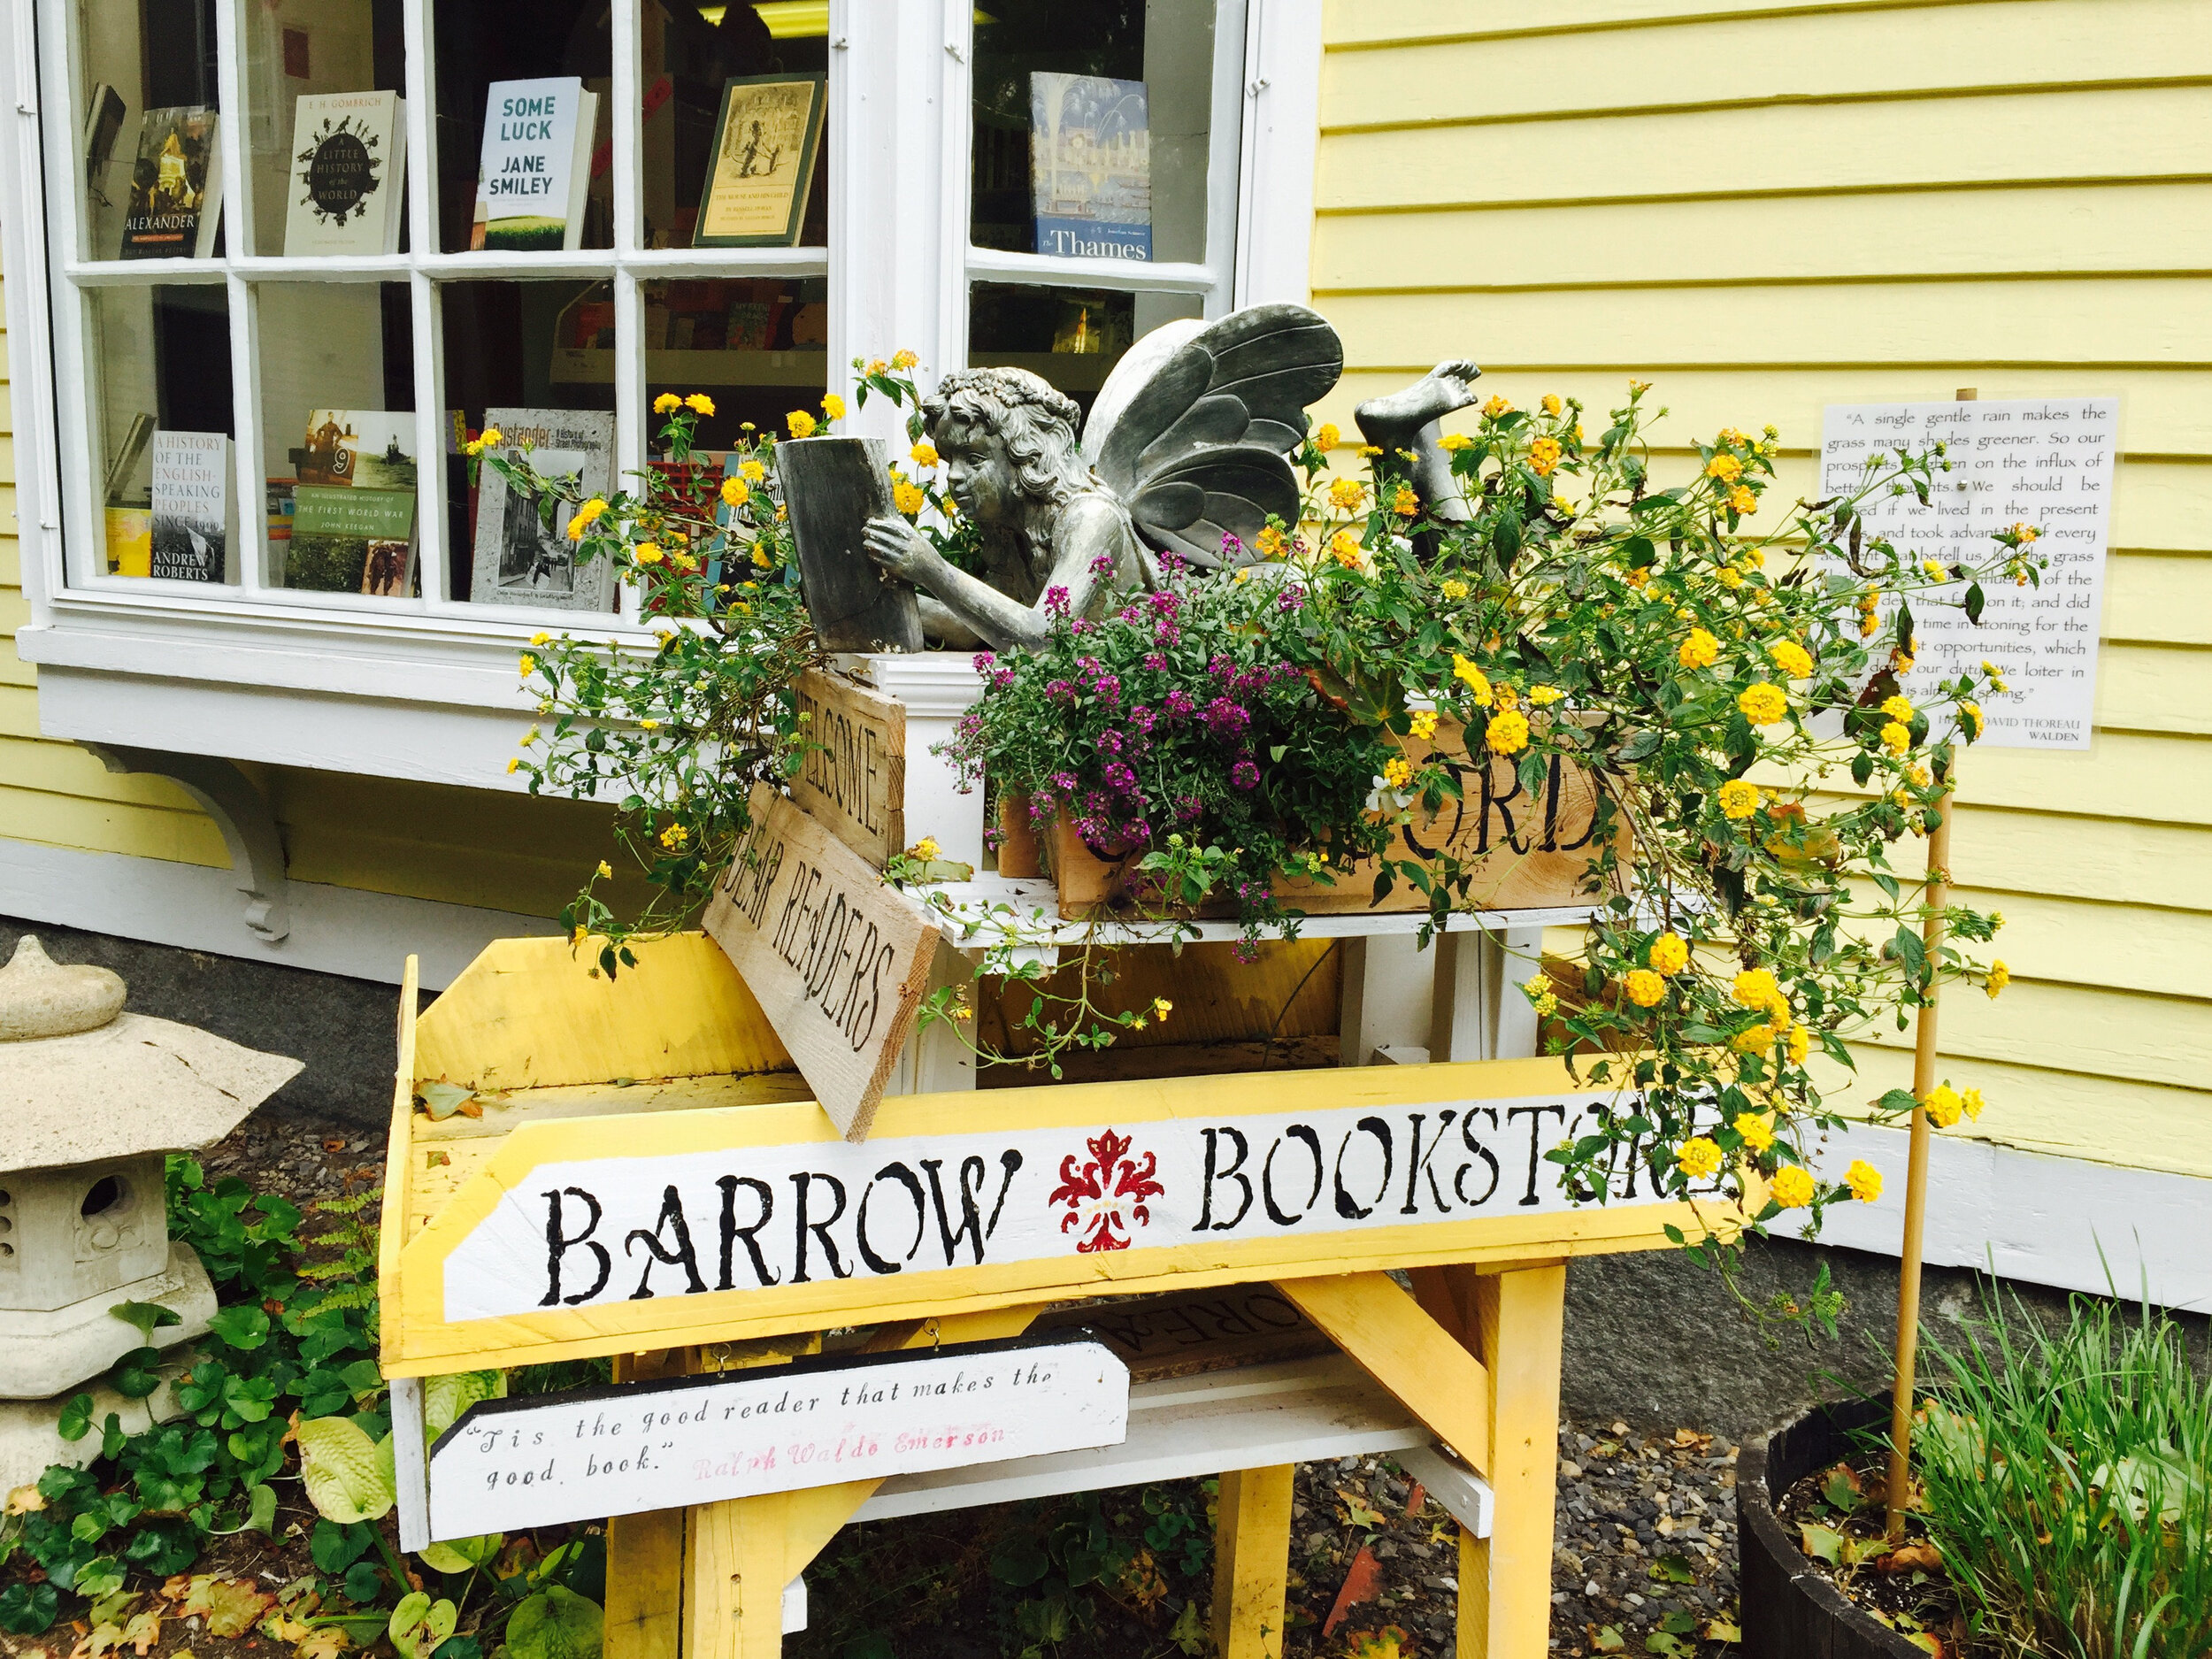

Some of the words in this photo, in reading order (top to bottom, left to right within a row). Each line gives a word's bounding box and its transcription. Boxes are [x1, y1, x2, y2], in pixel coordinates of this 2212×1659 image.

[319, 100, 326, 109] H
[332, 97, 381, 108] GOMBRICH
[503, 96, 556, 117] SOME
[501, 119, 553, 142] LUCK
[323, 149, 359, 160] LITTLE
[317, 162, 364, 173] HISTORY
[501, 155, 545, 173] JANE
[318, 189, 358, 200] WORLD
[488, 177, 553, 196] SMILEY
[125, 214, 195, 230] ALEXANDER
[1050, 229, 1147, 260] Thames
[1875, 408, 1916, 429] single
[1925, 407, 1971, 428] gentle
[1983, 410, 2011, 422] rain
[2023, 404, 2070, 421] makes
[2082, 403, 2107, 419] the
[157, 436, 163, 448] A
[166, 436, 220, 450] HISTORY
[1826, 438, 1865, 454] grass
[1873, 438, 1910, 449] many
[1977, 434, 2039, 450] greener.
[2047, 432, 2070, 444] So
[2078, 433, 2106, 443] our
[155, 452, 172, 464] OF
[176, 452, 203, 465] THE
[332, 447, 350, 474] 9
[1975, 459, 1994, 469] on
[2003, 452, 2028, 468] the
[2035, 451, 2077, 468] influx
[2085, 451, 2105, 467] of
[156, 467, 216, 481] ENGLISH-
[155, 482, 220, 499] SPEAKING
[1972, 480, 1994, 492] We
[2011, 475, 2063, 492] should
[2081, 475, 2101, 491] be
[155, 498, 210, 513] PEOPLES
[298, 504, 313, 513] THE
[319, 505, 342, 515] FIRST
[348, 508, 380, 518] WORLD
[1887, 500, 1900, 516] if
[1908, 506, 1927, 516] we
[1938, 500, 1970, 516] lived
[1981, 503, 1993, 515] in
[2005, 499, 2029, 515] the
[2039, 503, 2099, 522] present
[154, 514, 190, 528] SINCE
[195, 520, 219, 531] 1900
[345, 522, 375, 531] KEEGAN
[1878, 524, 1905, 538] and
[1911, 523, 1943, 538] took
[2055, 528, 2096, 544] every
[153, 552, 208, 567] ANDREW
[1920, 545, 1961, 561] befell
[1965, 552, 1985, 563] us,
[2053, 552, 2094, 567] grass
[153, 565, 209, 581] ROBERTS
[2044, 569, 2063, 586] of
[2068, 570, 2093, 586] the
[1916, 591, 1945, 607] that
[1986, 598, 2005, 608] on
[2011, 595, 2025, 610] it;
[2032, 593, 2061, 609] and
[2066, 593, 2091, 609] did
[1923, 618, 1952, 629] time
[1957, 617, 1970, 629] in
[2035, 615, 2059, 632] for
[2063, 616, 2088, 632] the
[1934, 641, 2037, 658] opportunities,
[2045, 639, 2087, 655] which
[1916, 665, 1943, 674] our
[2024, 661, 2065, 677] loiter
[2071, 665, 2085, 678] in
[1906, 687, 1917, 696] is
[1982, 717, 2019, 727] DAVID
[2022, 718, 2081, 729] THOREAU
[2029, 731, 2080, 741] WALDEN
[772, 860, 895, 1054] READERS
[536, 1148, 1024, 1308] BARROW
[576, 1411, 622, 1439] the
[642, 1400, 710, 1433] good
[724, 1391, 821, 1421] reader
[840, 1382, 901, 1407] that
[912, 1371, 995, 1398] makes
[1012, 1363, 1052, 1386] the
[487, 1458, 554, 1491] good
[693, 1447, 778, 1481] Ralph
[787, 1435, 879, 1465] Waldo
[894, 1426, 1006, 1455] Emerson
